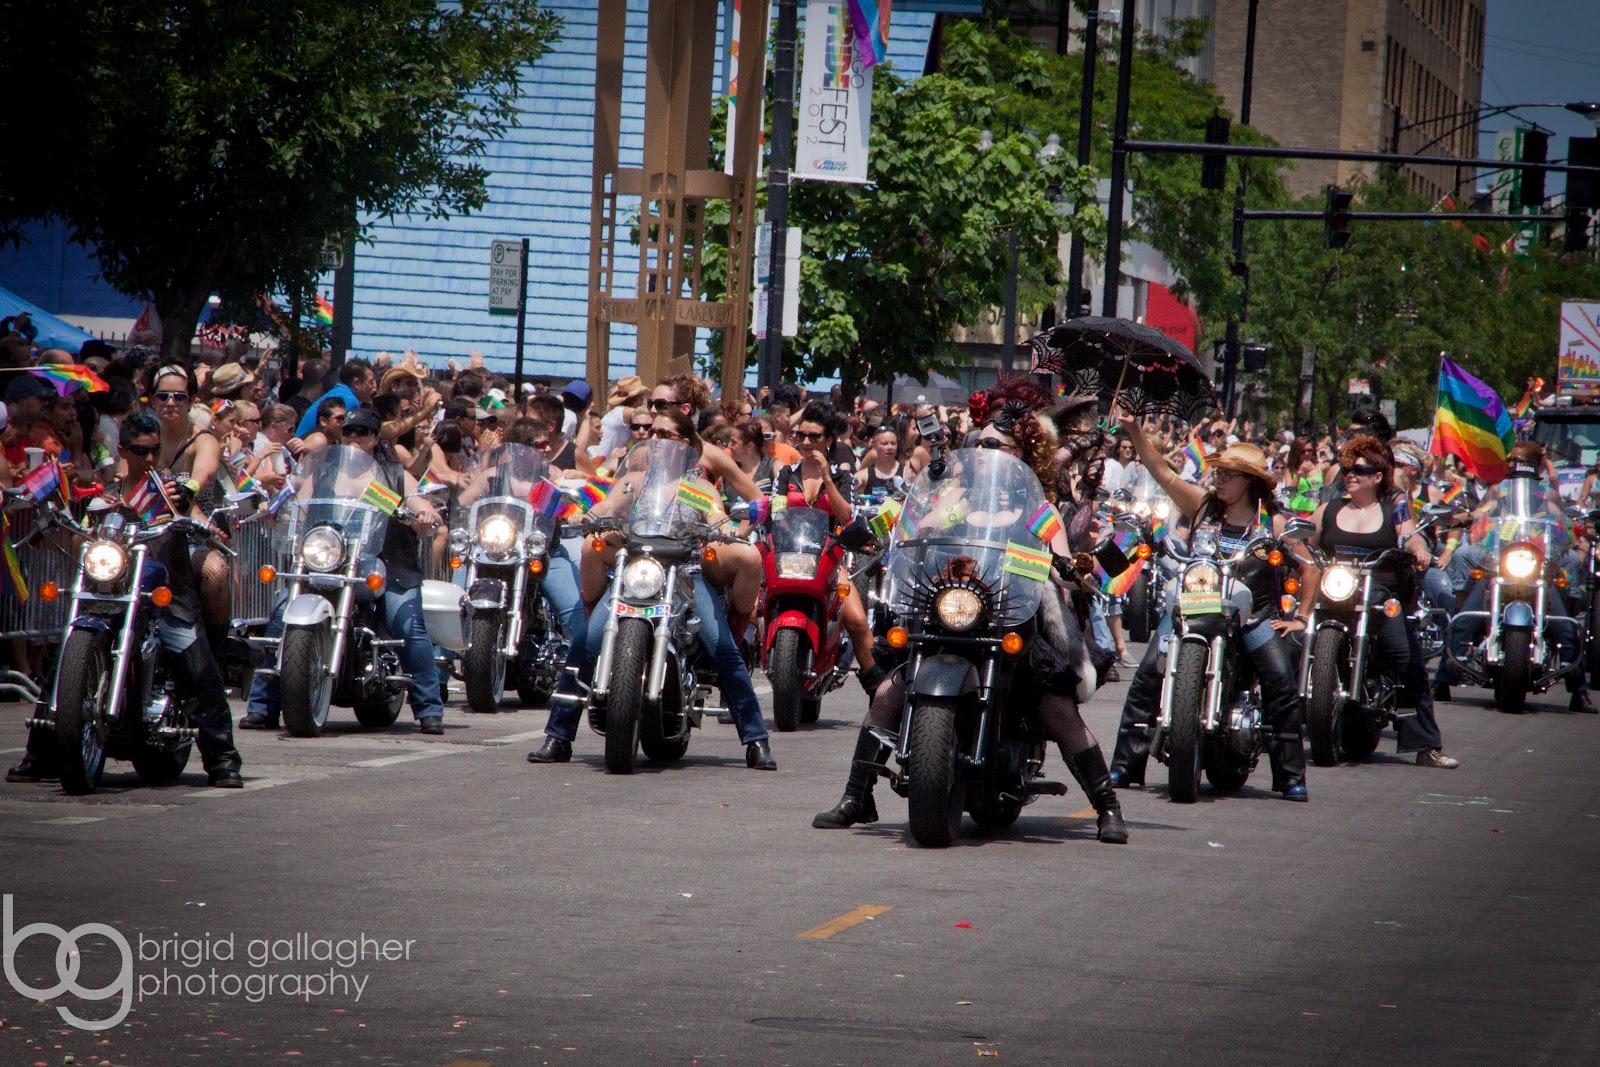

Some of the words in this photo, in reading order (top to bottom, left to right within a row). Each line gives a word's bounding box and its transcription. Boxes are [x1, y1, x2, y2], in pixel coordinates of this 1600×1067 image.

[492, 268, 503, 277] PAY
[505, 269, 518, 278] FOR
[491, 278, 518, 288] PARKING
[491, 287, 500, 295] AT
[500, 288, 513, 296] PAY
[490, 296, 504, 305] BOX
